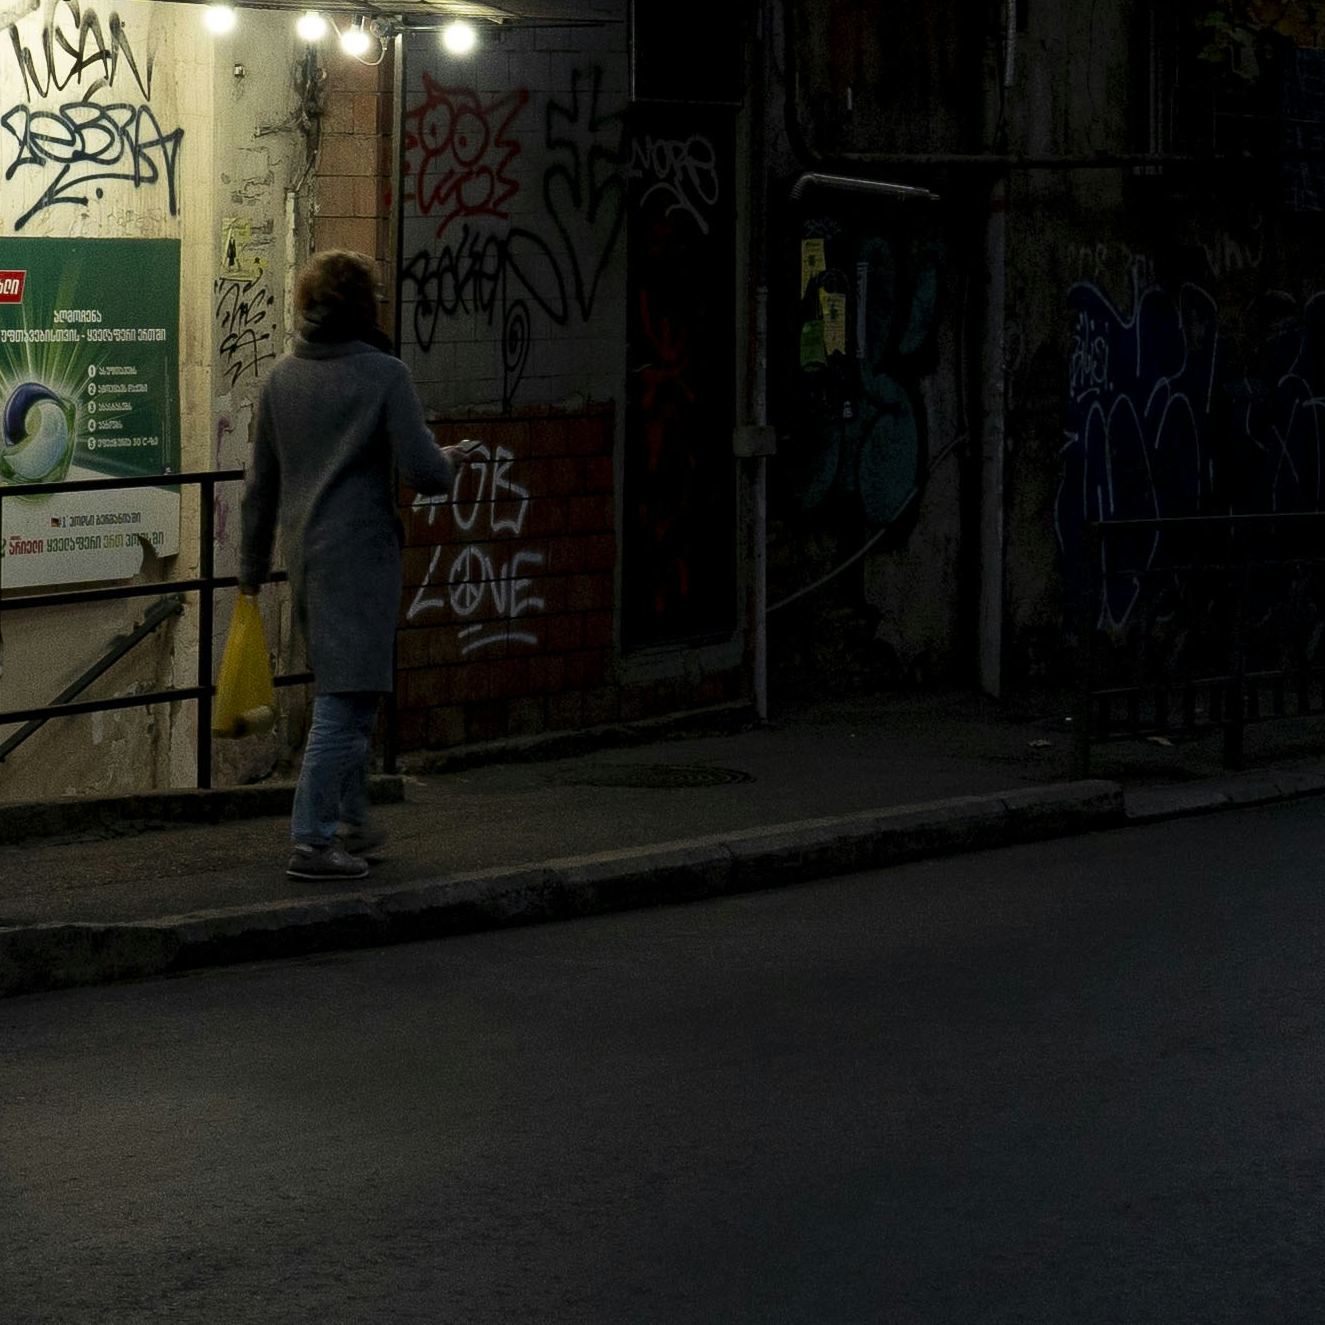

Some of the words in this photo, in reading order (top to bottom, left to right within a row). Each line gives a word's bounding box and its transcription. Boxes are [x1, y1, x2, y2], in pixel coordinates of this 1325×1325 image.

[53, 309, 103, 324] აღმოჩენა
[86, 328, 137, 343] ყველაფერი
[8, 538, 44, 555] არიელი
[46, 536, 102, 553] ყველაფერი
[102, 535, 124, 548] ერთ
[407, 544, 546, 622] LOVE
